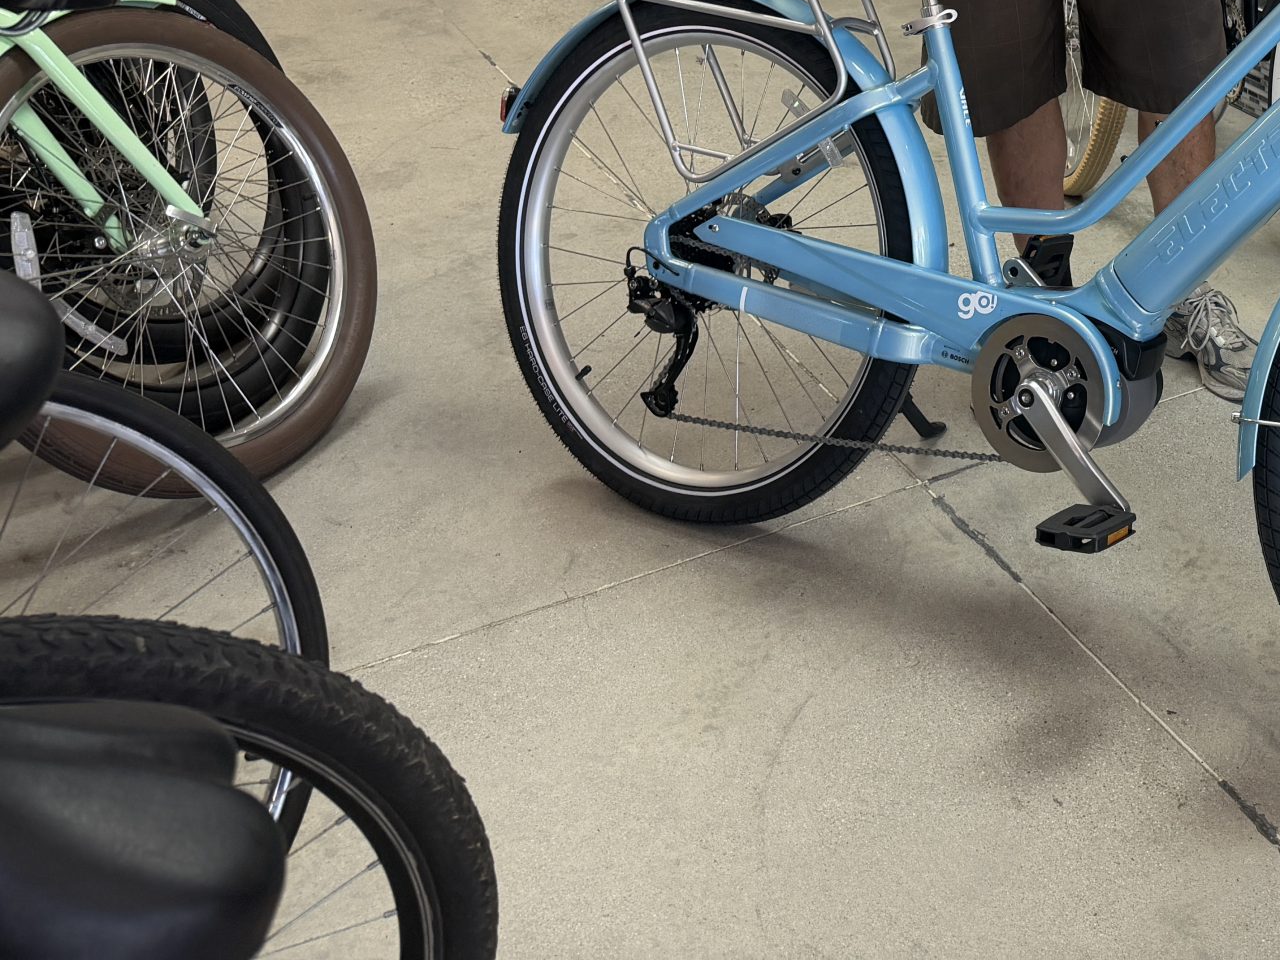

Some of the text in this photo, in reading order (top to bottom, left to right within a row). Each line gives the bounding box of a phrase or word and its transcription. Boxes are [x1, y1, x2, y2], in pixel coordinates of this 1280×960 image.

[957, 290, 998, 320] go!
[949, 353, 970, 365] BOSCH
[520, 326, 569, 424] E6 HARD-CASE LITE
